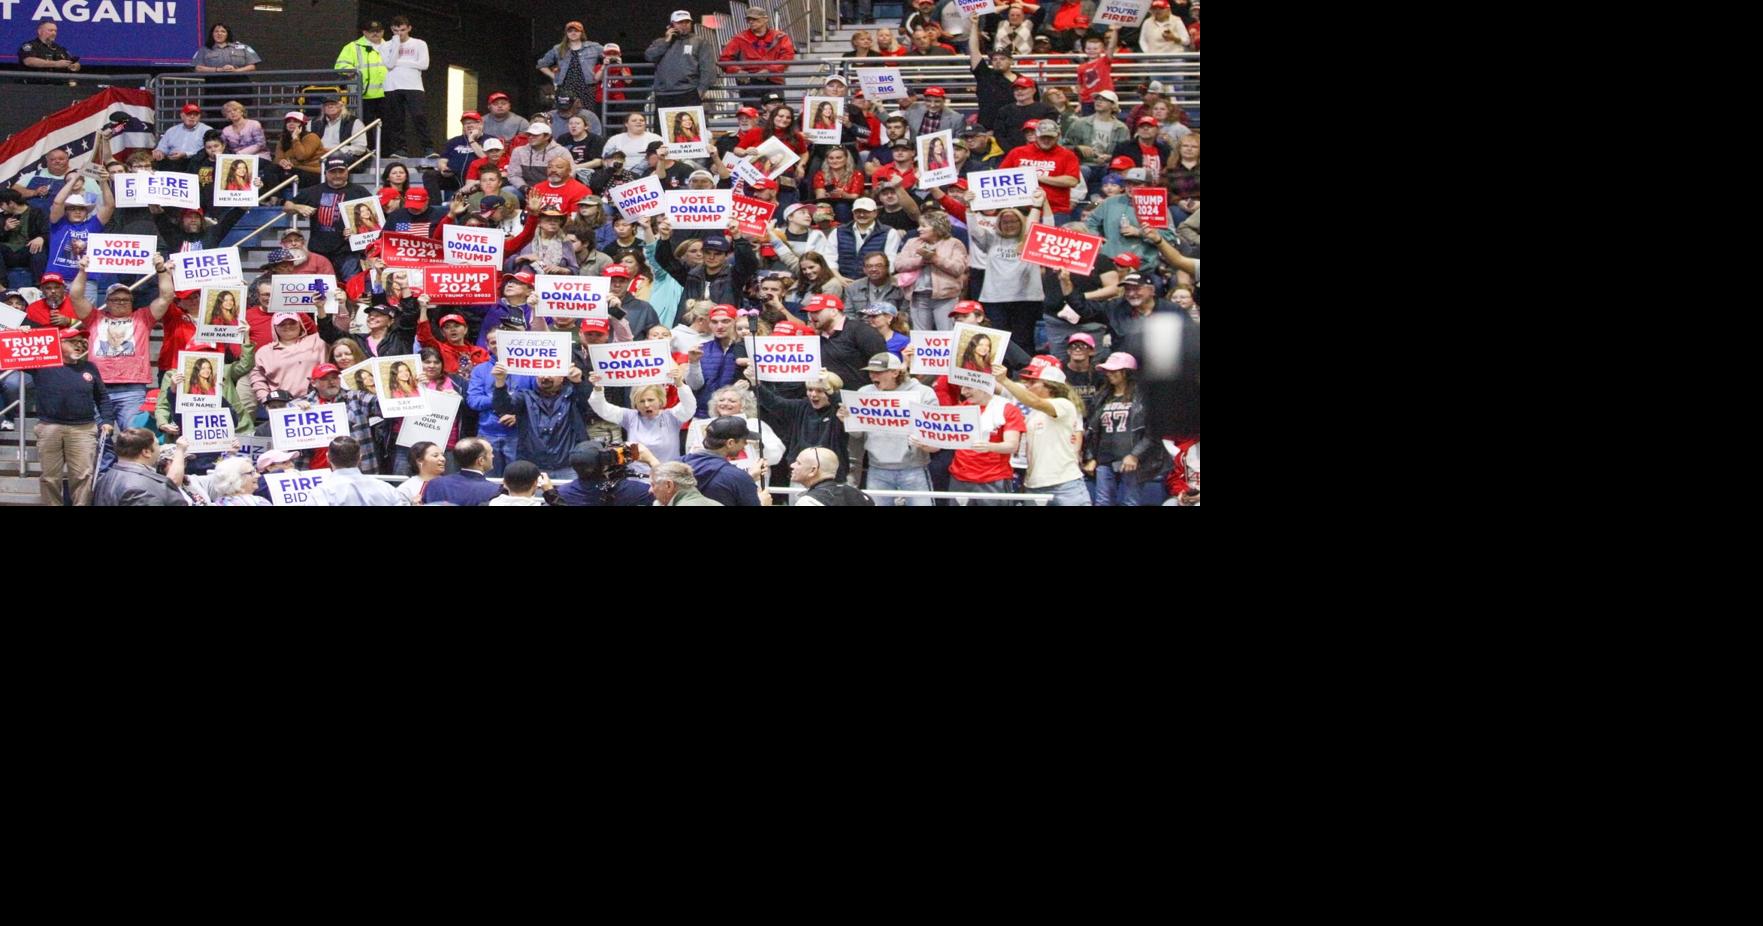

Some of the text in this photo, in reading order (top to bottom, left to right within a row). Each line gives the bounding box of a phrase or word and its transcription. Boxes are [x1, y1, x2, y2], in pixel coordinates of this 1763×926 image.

[32, 0, 177, 24] AGAIN!
[980, 173, 1026, 188] FIRE
[148, 187, 189, 198] BIDEN
[620, 184, 647, 198] VOTE
[981, 186, 1028, 199] BIDEN
[618, 191, 659, 209] DONALD
[680, 196, 715, 204] VOTE
[1134, 195, 1163, 205] TRUMP
[625, 201, 658, 216] TRUMP
[670, 205, 725, 213] DONALD
[732, 200, 768, 216] RUMP
[1137, 206, 1159, 215] 2024
[675, 214, 721, 222] TRUMP
[732, 210, 757, 223] 024
[389, 238, 443, 250] TRUMP
[456, 233, 488, 244] VOTE
[1035, 231, 1093, 252] TRUMP
[104, 240, 140, 249] VOTE
[447, 241, 497, 254] DONALD
[93, 248, 150, 258] DONALD
[396, 248, 437, 258] 2024
[451, 250, 493, 262] TRUMP
[1039, 243, 1081, 260] 2024
[97, 257, 145, 266] TRUMP
[183, 254, 229, 269] FIRE
[184, 266, 231, 279] BIDEN
[431, 273, 490, 283] TRUMP
[281, 283, 305, 291] TOO
[438, 283, 481, 293] 2024
[553, 282, 592, 292] VOTE
[283, 296, 299, 304] TO
[541, 291, 602, 302] DONALD
[547, 301, 597, 311] TRUMP
[2, 335, 54, 348] TRUMP
[527, 339, 556, 347] BIDEN
[925, 338, 951, 347] VOT
[11, 346, 49, 357] 2024
[506, 347, 557, 357] YOU'RE
[609, 348, 651, 359] VOTE
[764, 343, 804, 353] VOTE
[917, 347, 950, 356] DONA
[506, 358, 561, 369] FIRED!
[599, 357, 664, 370] DONALD
[754, 354, 814, 363] DONALD
[921, 357, 949, 367] TRU
[605, 368, 661, 380] TRUMP
[758, 364, 811, 374] TRUMP
[859, 398, 900, 407] VOTE
[850, 406, 910, 418] DONALD
[922, 410, 961, 422] VOTE
[193, 414, 227, 428] FIRE
[283, 410, 335, 426] FIRE
[421, 416, 437, 424] OUR
[857, 416, 910, 427] TRUMP
[1100, 411, 1129, 433] 47
[414, 421, 441, 431] ANGELS
[915, 419, 974, 432] DONALD
[194, 429, 229, 440] BIDEN
[285, 424, 337, 439] BIDEN
[919, 429, 970, 442] TRUMP
[284, 491, 309, 504] BID
